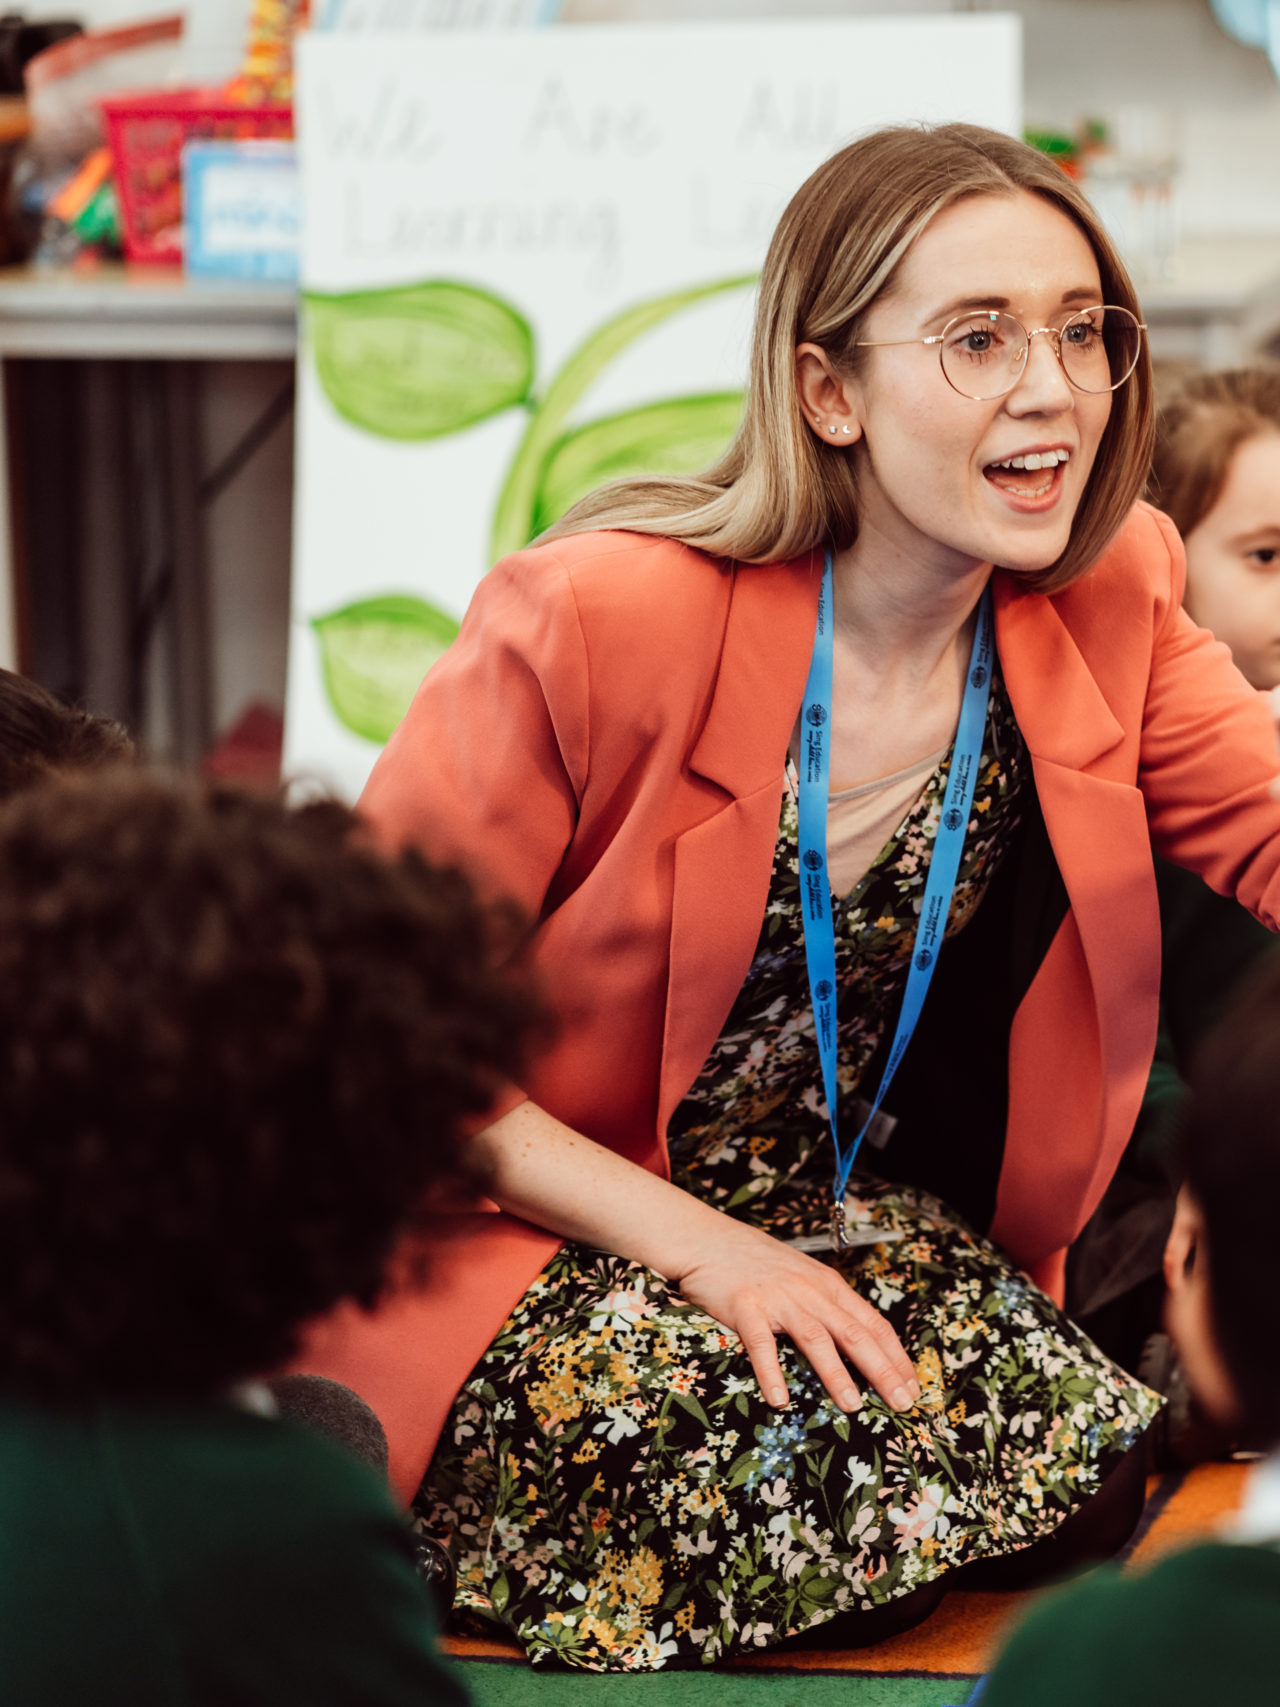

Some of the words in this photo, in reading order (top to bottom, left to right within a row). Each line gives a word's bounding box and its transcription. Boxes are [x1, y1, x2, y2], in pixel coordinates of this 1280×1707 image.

[313, 73, 443, 163] We
[518, 70, 664, 158] Are
[342, 177, 624, 297] Learning
[813, 730, 823, 746] Sing
[814, 747, 824, 783] Education
[953, 754, 965, 789] Education
[950, 790, 960, 805] Sing
